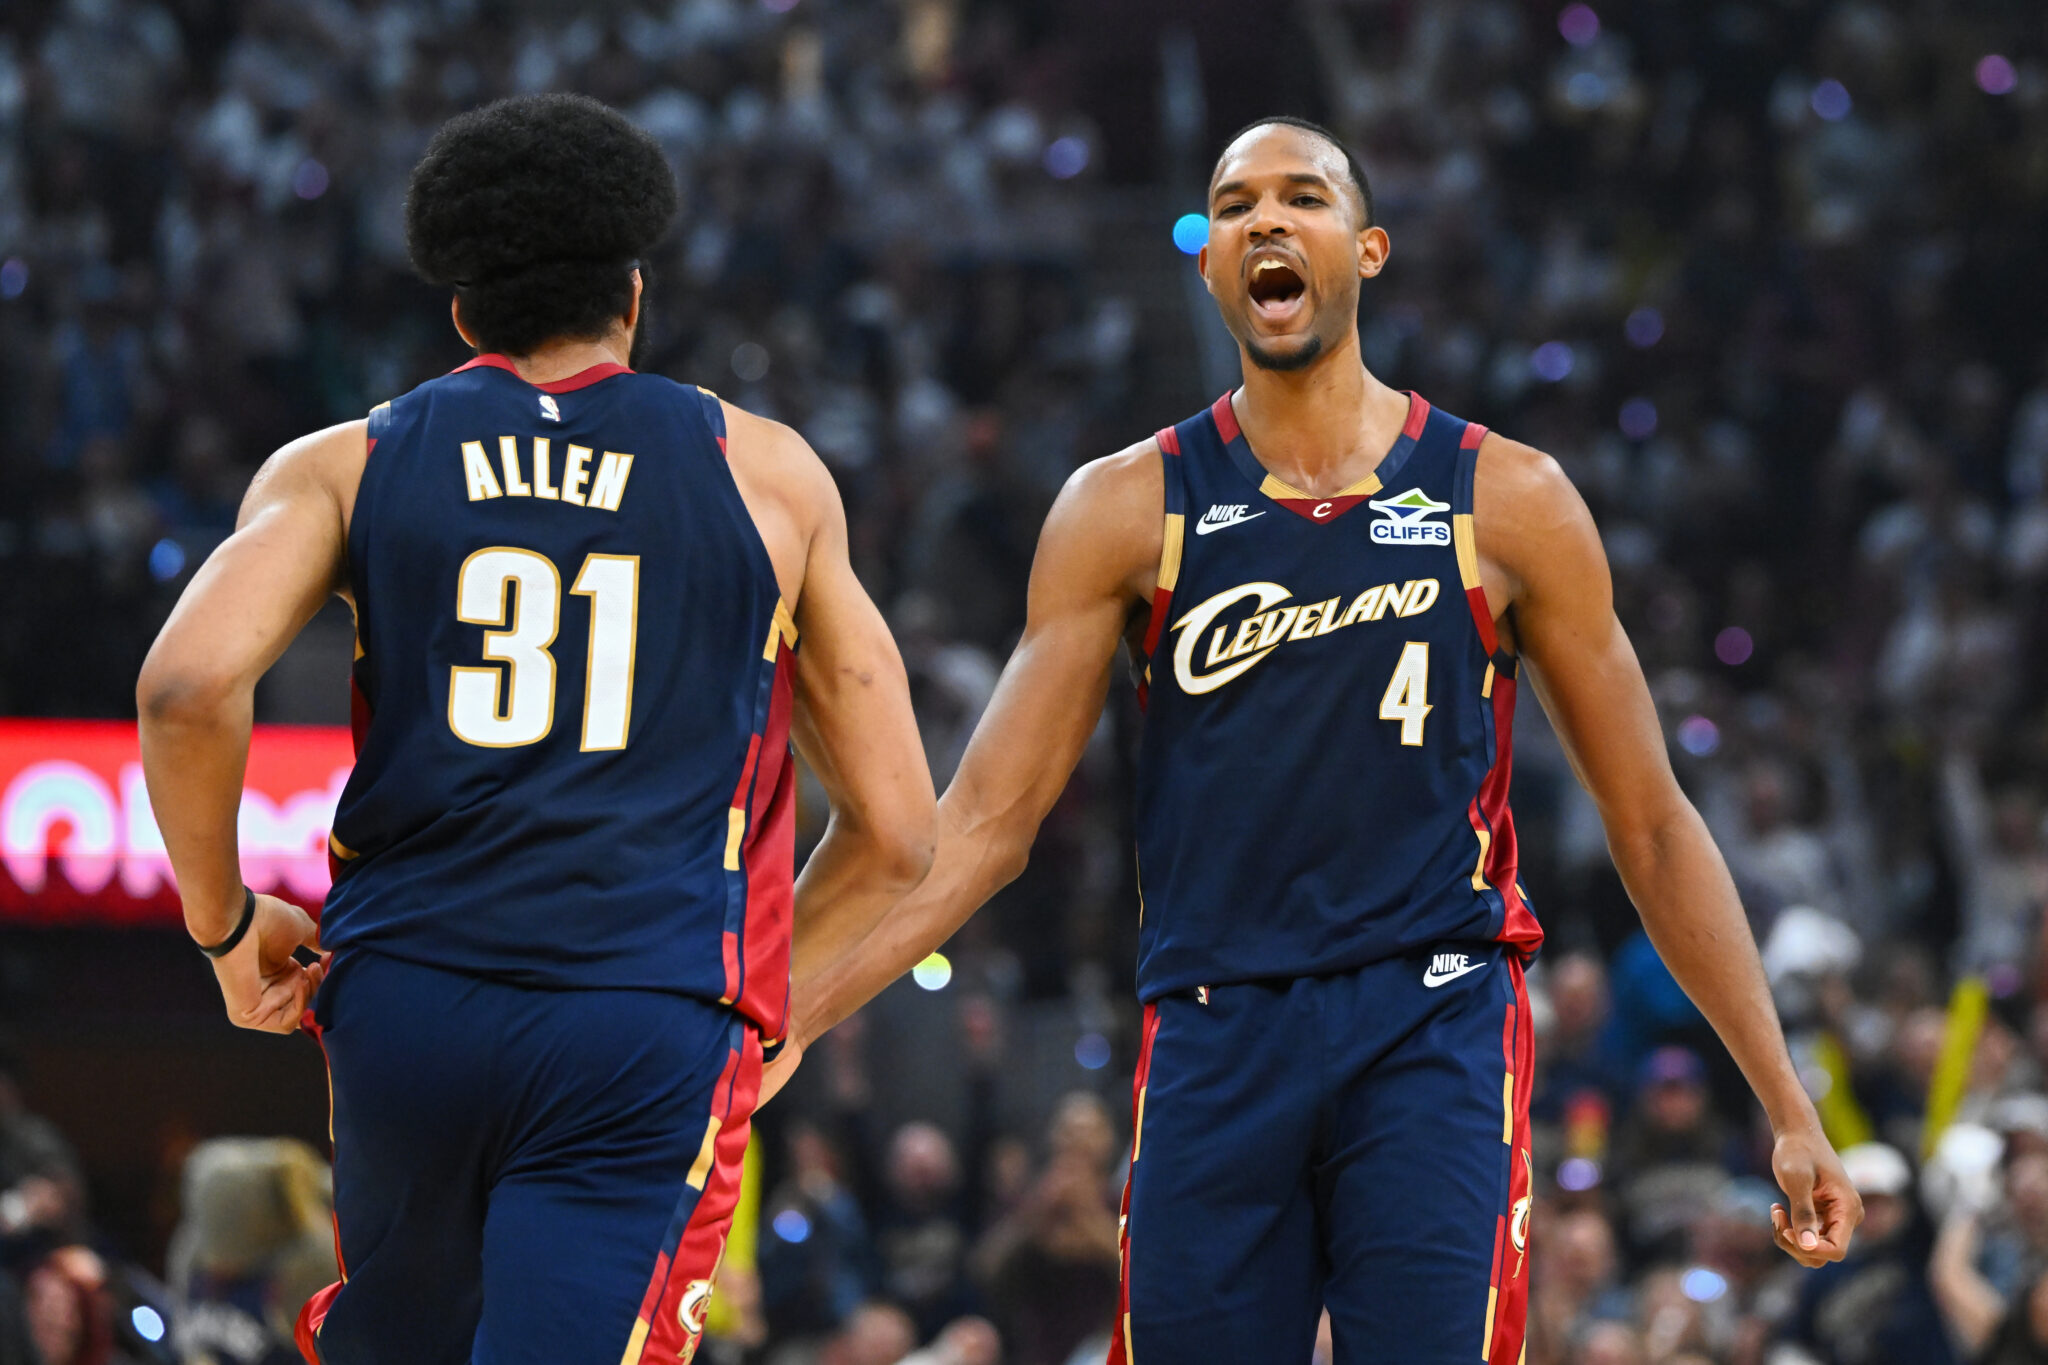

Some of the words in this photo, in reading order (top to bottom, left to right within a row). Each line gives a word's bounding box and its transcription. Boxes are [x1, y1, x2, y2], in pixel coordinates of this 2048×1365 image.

[461, 436, 634, 511] ALLEN
[1205, 504, 1249, 522] NIKE
[1312, 502, 1332, 518] C
[1373, 524, 1449, 541] CLIFFS
[447, 546, 640, 752] 31
[1170, 578, 1440, 695] CLEVELAND
[1379, 641, 1433, 746] 4
[1431, 953, 1469, 974] NIKE
